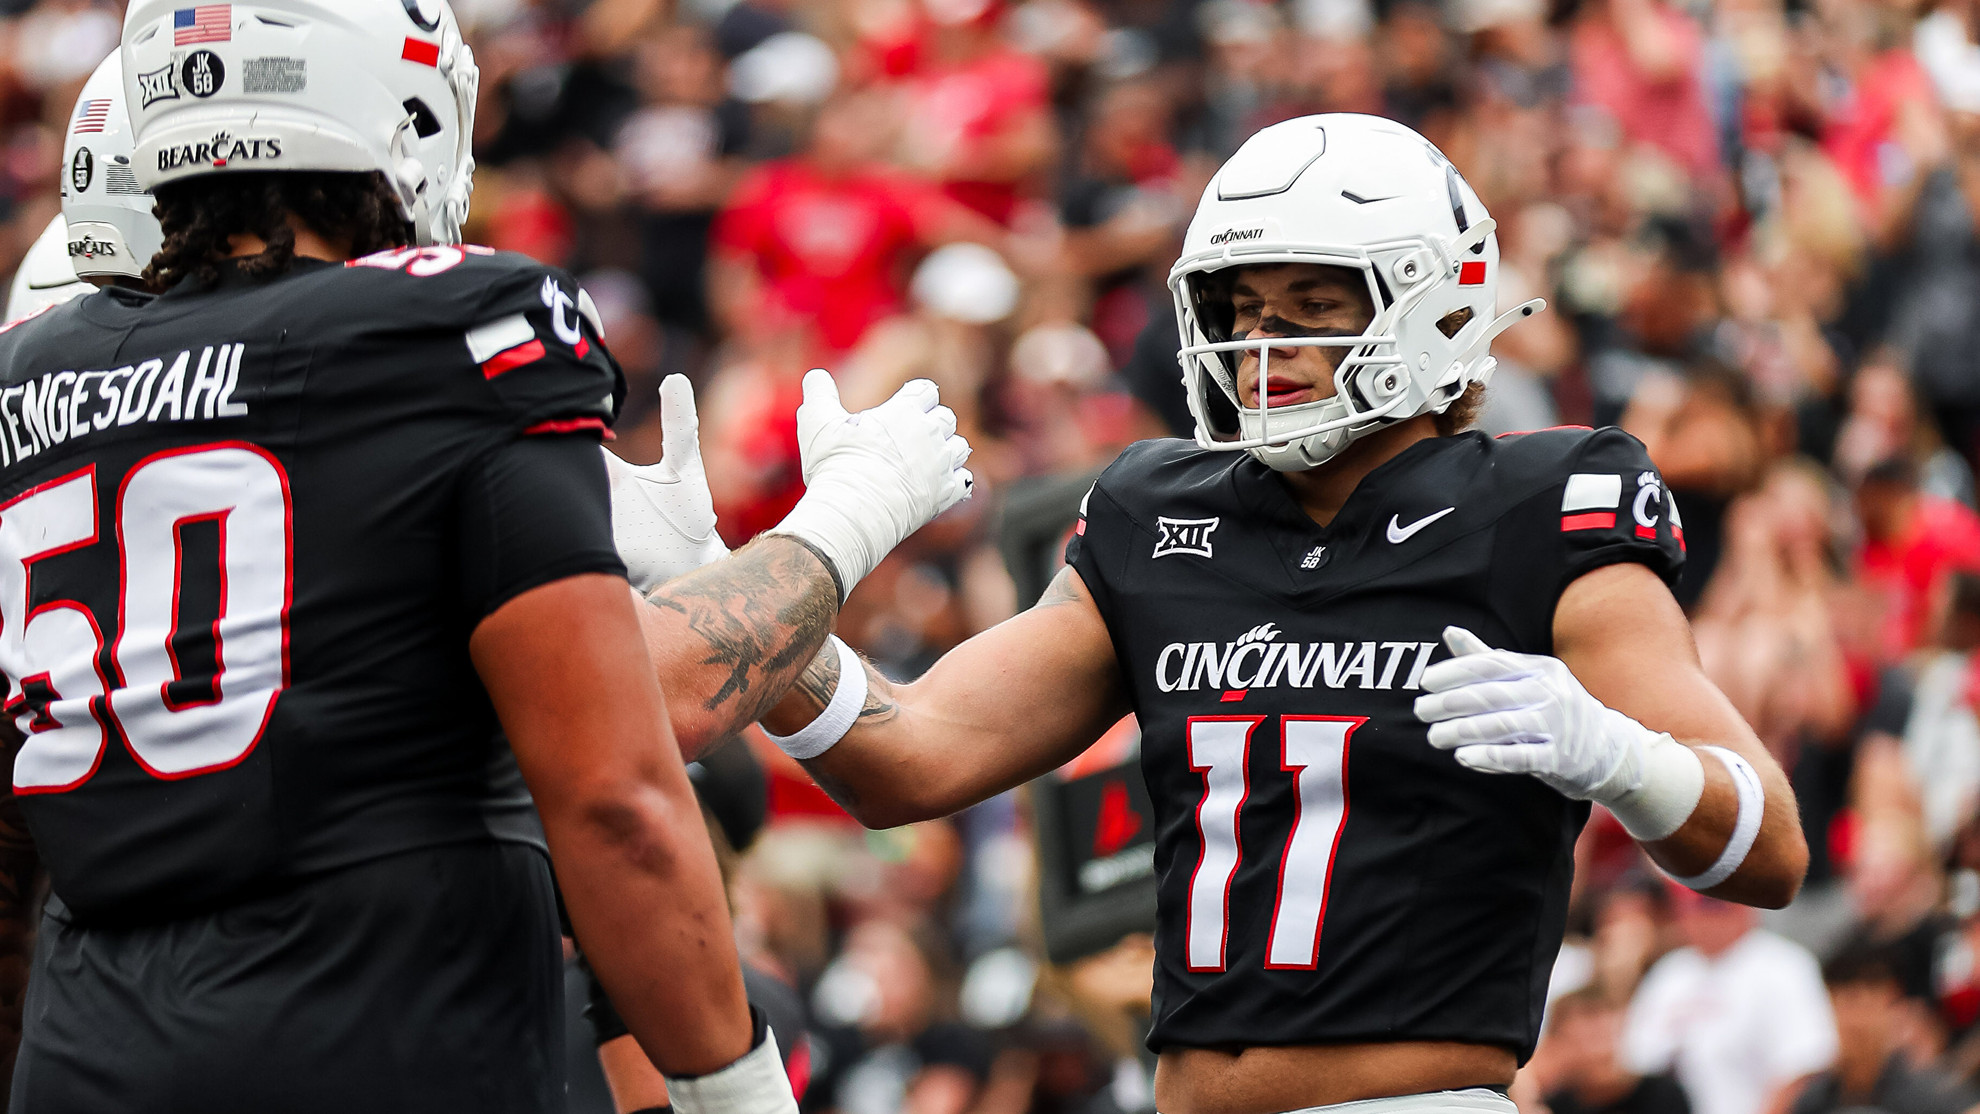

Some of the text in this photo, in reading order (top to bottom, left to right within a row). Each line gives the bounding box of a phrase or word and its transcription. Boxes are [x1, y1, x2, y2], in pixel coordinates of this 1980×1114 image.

[191, 53, 212, 73] JK
[193, 73, 213, 94] 58
[158, 131, 282, 171] BEARCATS
[1210, 228, 1264, 245] CINCINNATI
[1155, 519, 1216, 557] XII
[1307, 546, 1326, 557] JK
[1300, 556, 1320, 569] 58
[1156, 624, 1438, 692] CINCINNATI
[1186, 714, 1370, 973] 11
